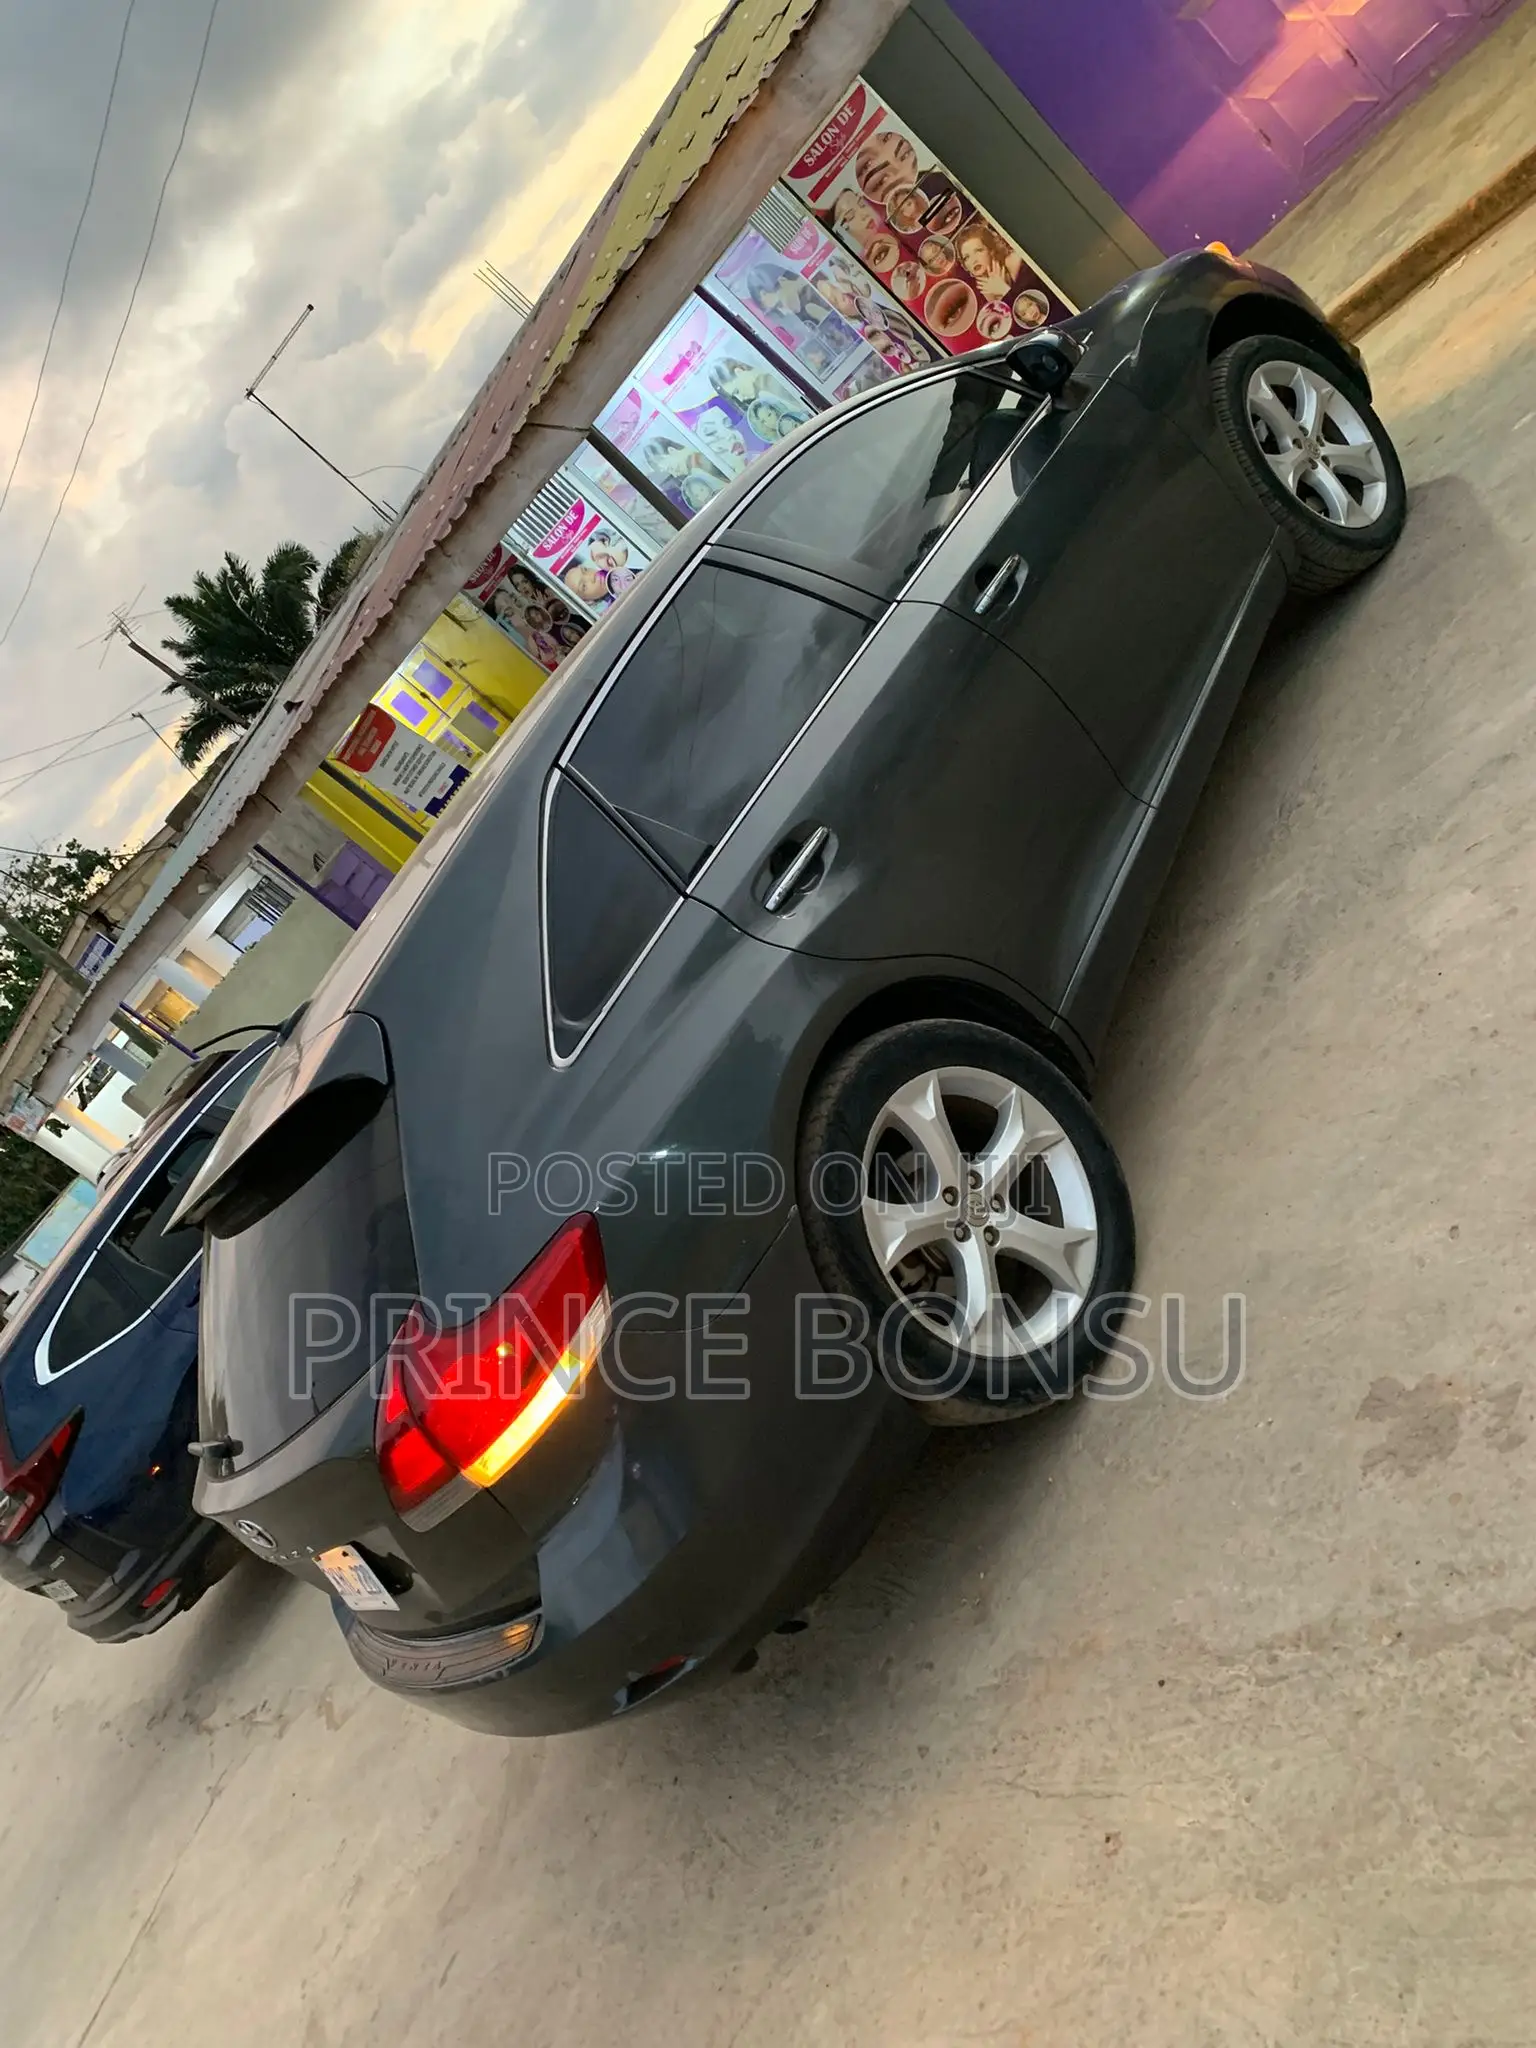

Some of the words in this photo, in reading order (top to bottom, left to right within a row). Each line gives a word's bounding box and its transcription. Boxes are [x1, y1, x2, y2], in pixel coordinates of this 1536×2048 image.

[802, 124, 840, 167] SALON
[836, 104, 856, 125] DE
[541, 522, 568, 551] SALON
[564, 510, 579, 525] DE
